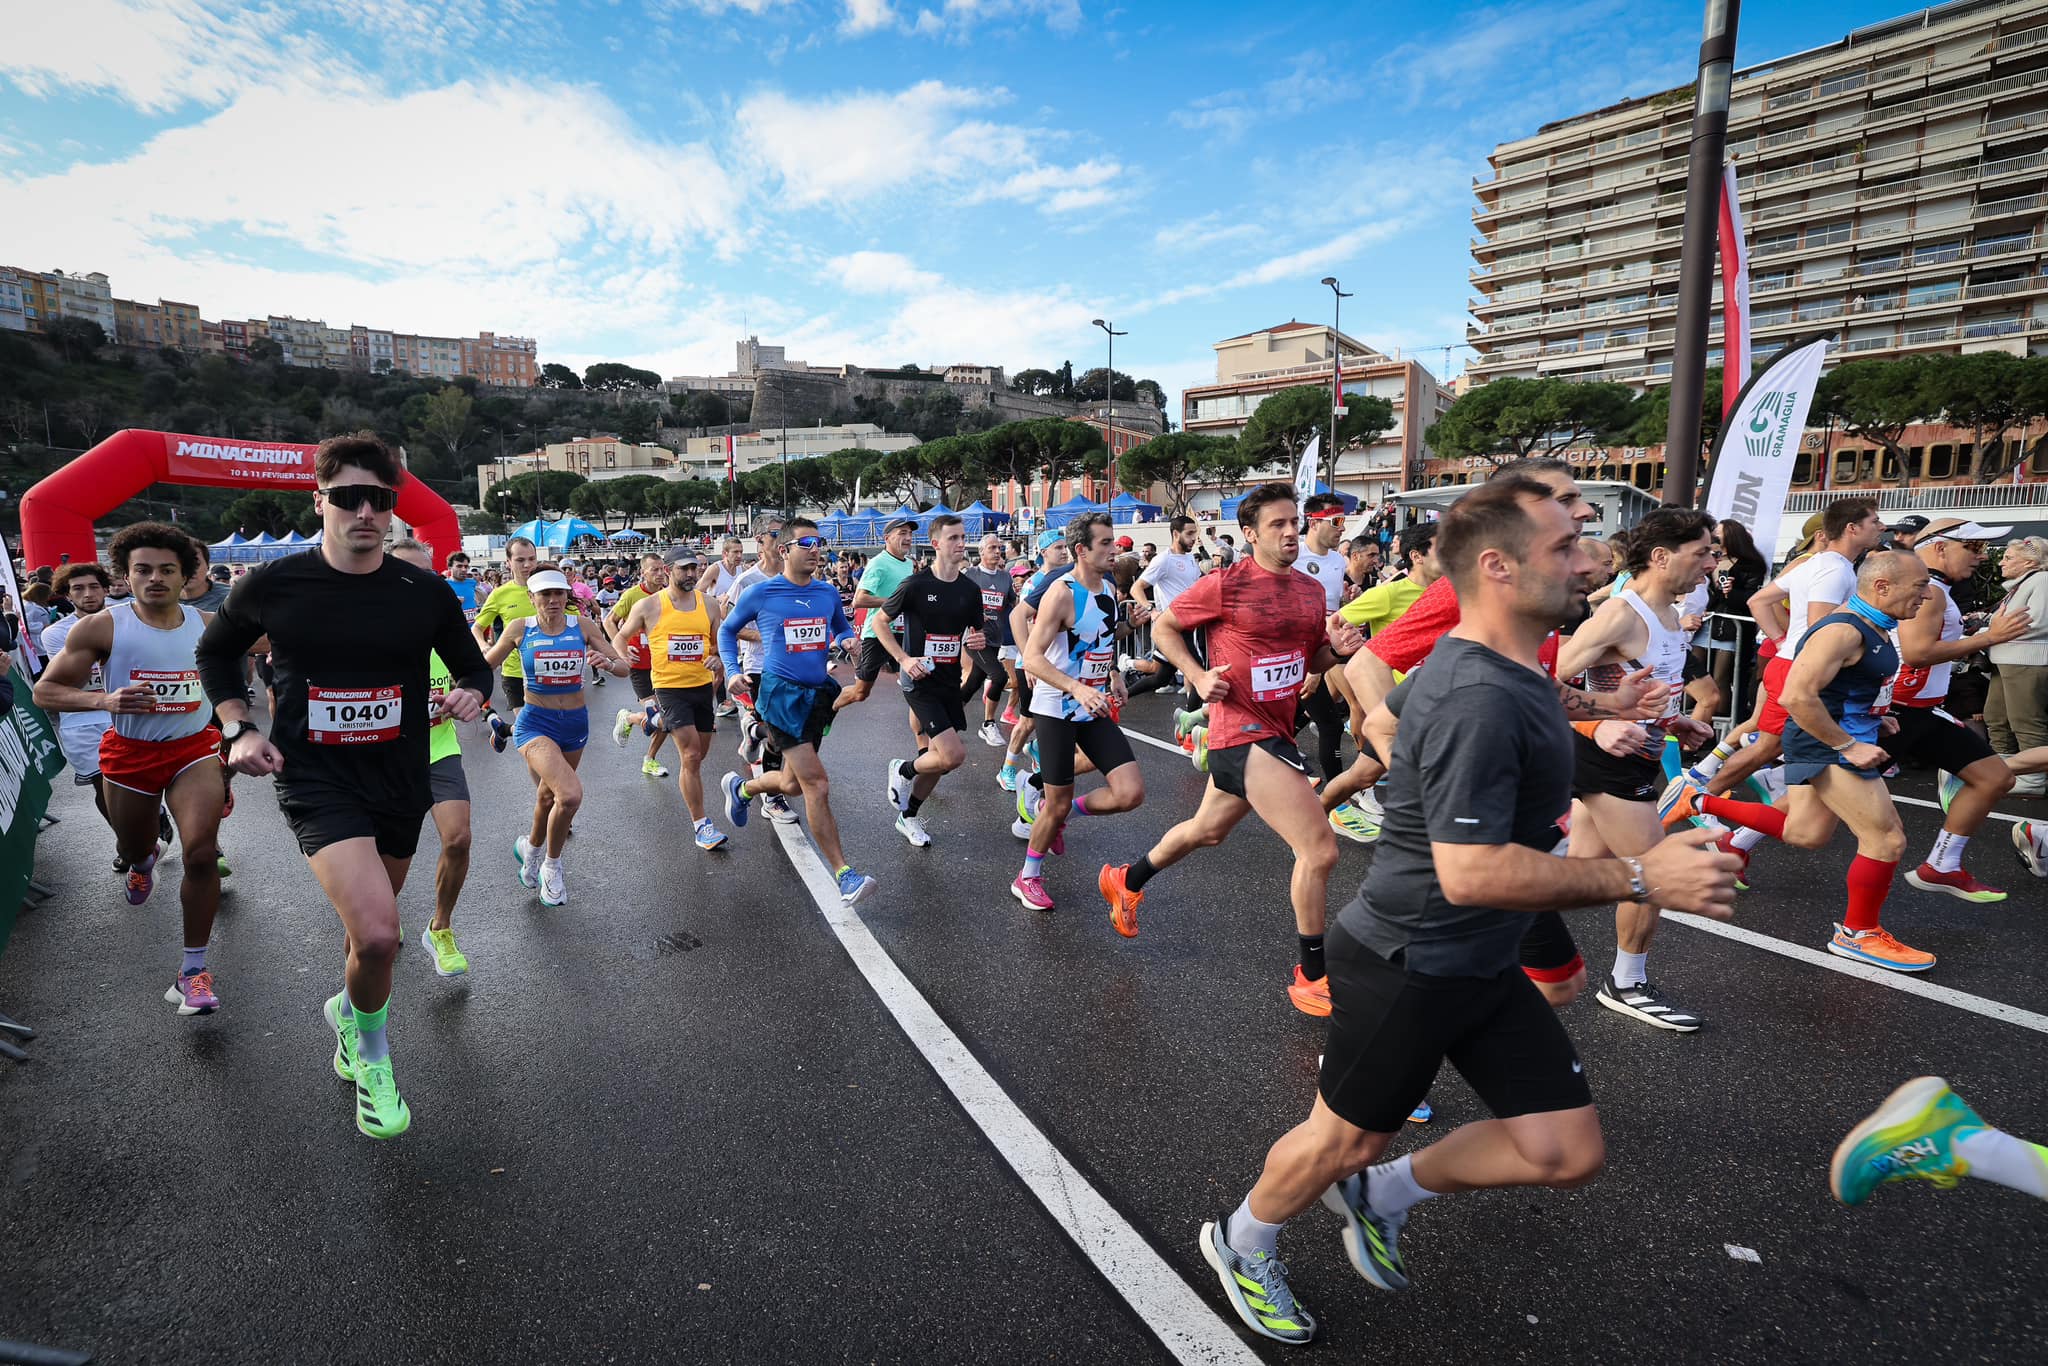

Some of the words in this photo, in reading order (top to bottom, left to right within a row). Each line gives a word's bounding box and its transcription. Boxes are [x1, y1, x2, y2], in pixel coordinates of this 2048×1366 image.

[1771, 391, 1798, 458] GRAMAGLIA
[175, 441, 304, 465] MONACORUN
[1623, 447, 1646, 459] DE
[230, 468, 241, 477] 10
[250, 470, 260, 478] 11
[792, 626, 821, 639] 1970
[673, 642, 699, 651] 2006
[931, 643, 956, 652] 1583
[543, 660, 577, 672] 1042
[1090, 662, 1109, 673] 176
[1263, 663, 1299, 682] 1770
[318, 690, 373, 699] MONACORUN
[325, 704, 388, 722] 1040
[340, 734, 379, 743] MONACO
